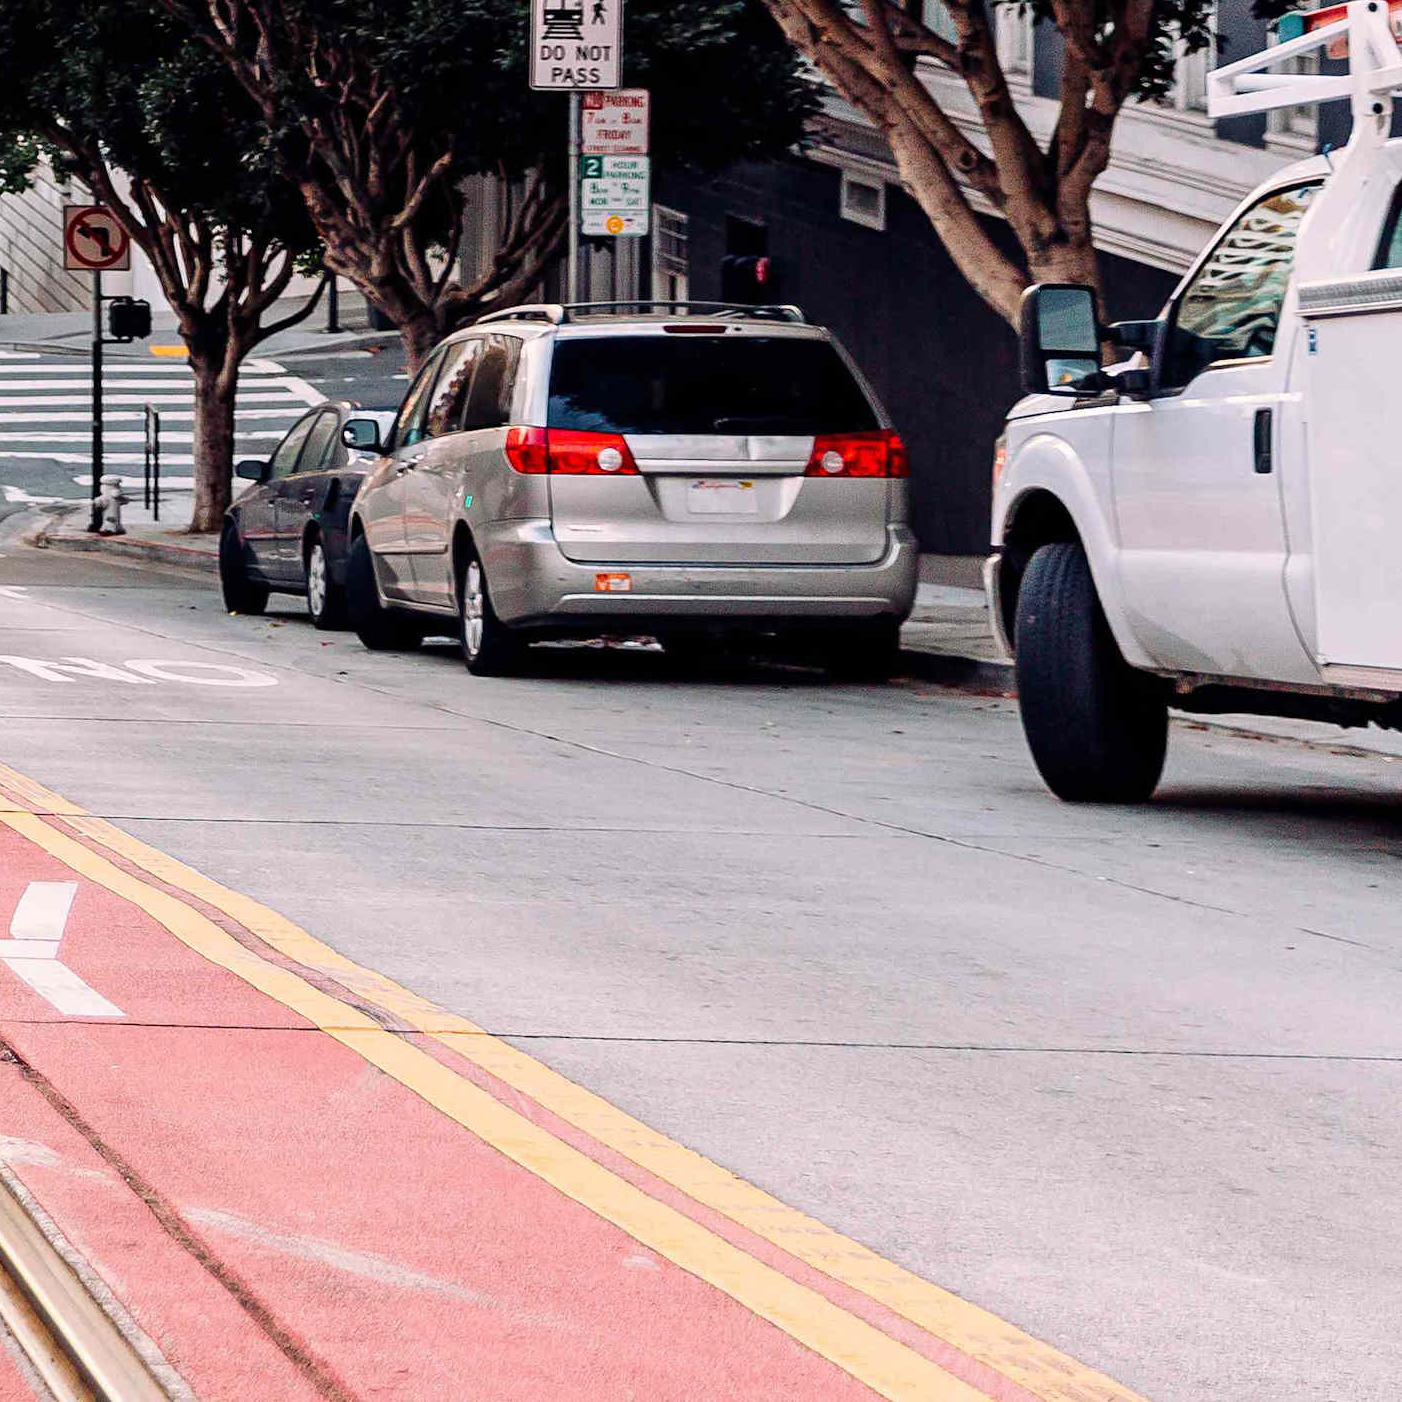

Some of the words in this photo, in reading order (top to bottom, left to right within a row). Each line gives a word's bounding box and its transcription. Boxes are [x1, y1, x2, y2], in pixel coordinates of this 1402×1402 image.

[540, 45, 565, 61] DO
[575, 45, 613, 61] NOT
[551, 67, 601, 84] PASS
[587, 159, 600, 176] 2
